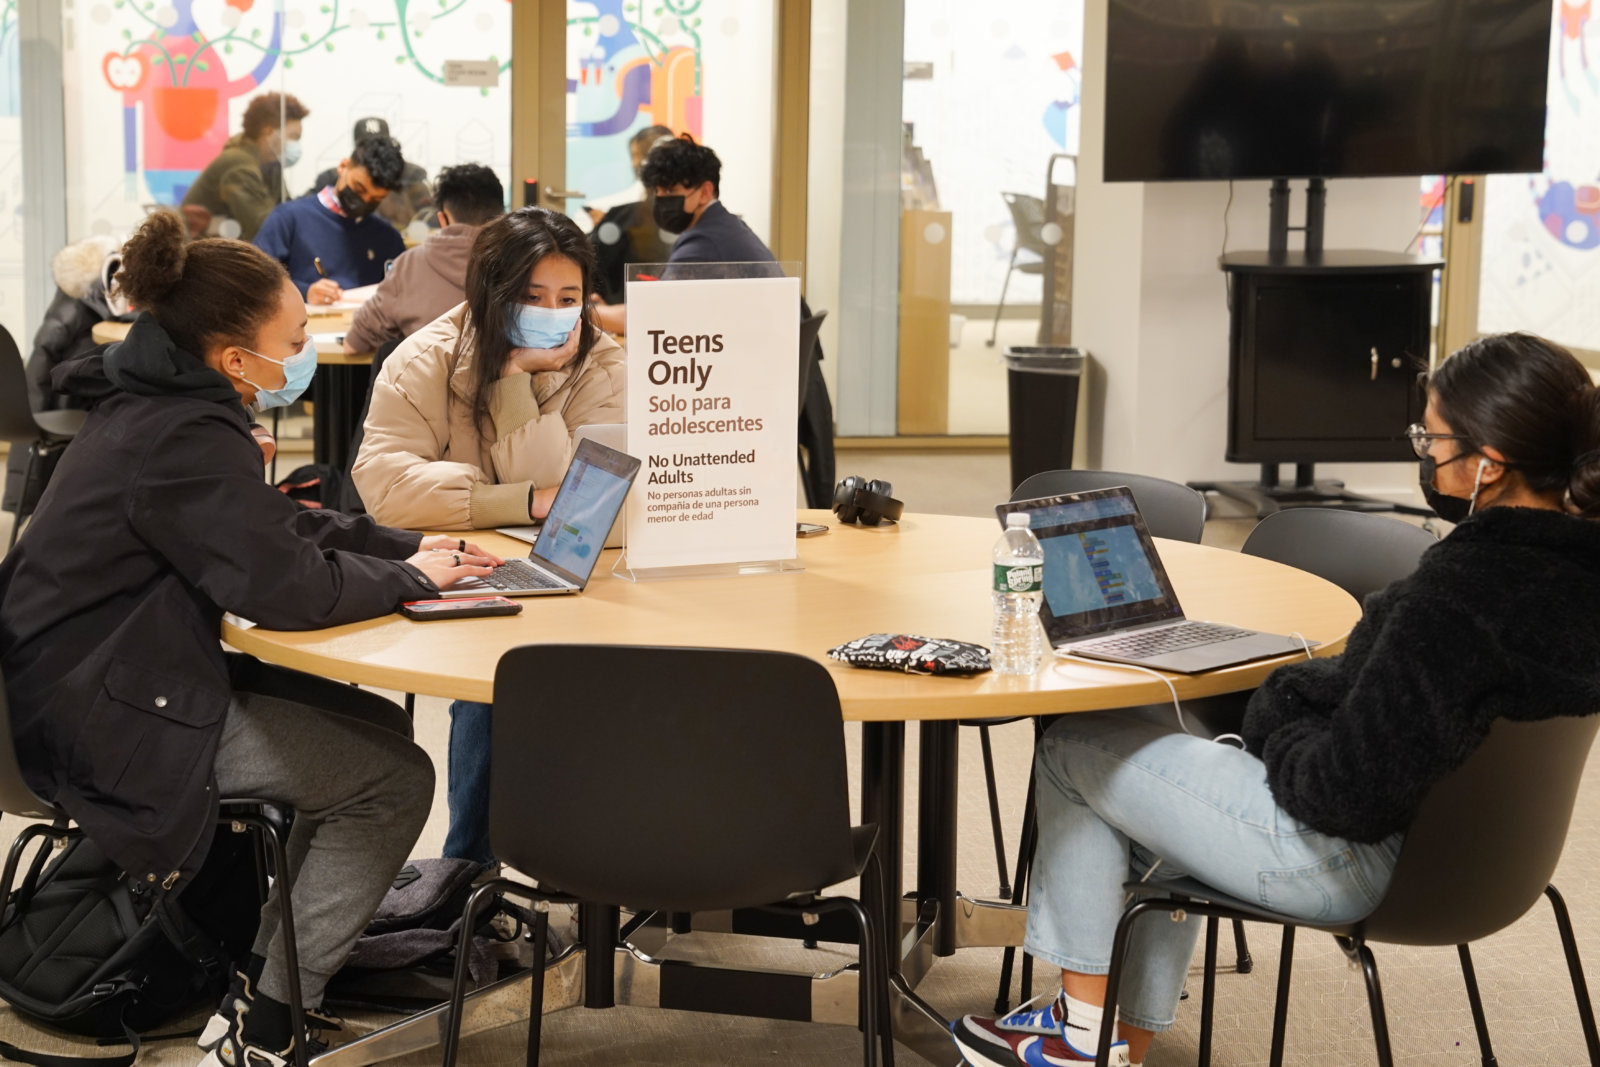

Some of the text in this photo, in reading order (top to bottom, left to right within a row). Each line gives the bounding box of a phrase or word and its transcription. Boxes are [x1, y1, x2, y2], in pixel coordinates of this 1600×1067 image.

[647, 330, 724, 355] Teens
[648, 358, 713, 391] Only
[649, 394, 731, 415] Solo para
[648, 416, 763, 436] adolescentes
[648, 449, 755, 468] No Unattended
[648, 470, 694, 485] Adults
[647, 486, 752, 501] No personas adultas sin
[692, 500, 704, 510] de
[705, 500, 722, 509] una
[724, 498, 759, 509] persona
[647, 511, 714, 524] menor de edad
[1006, 566, 1033, 579] Poland
[1007, 575, 1034, 588] Spring
